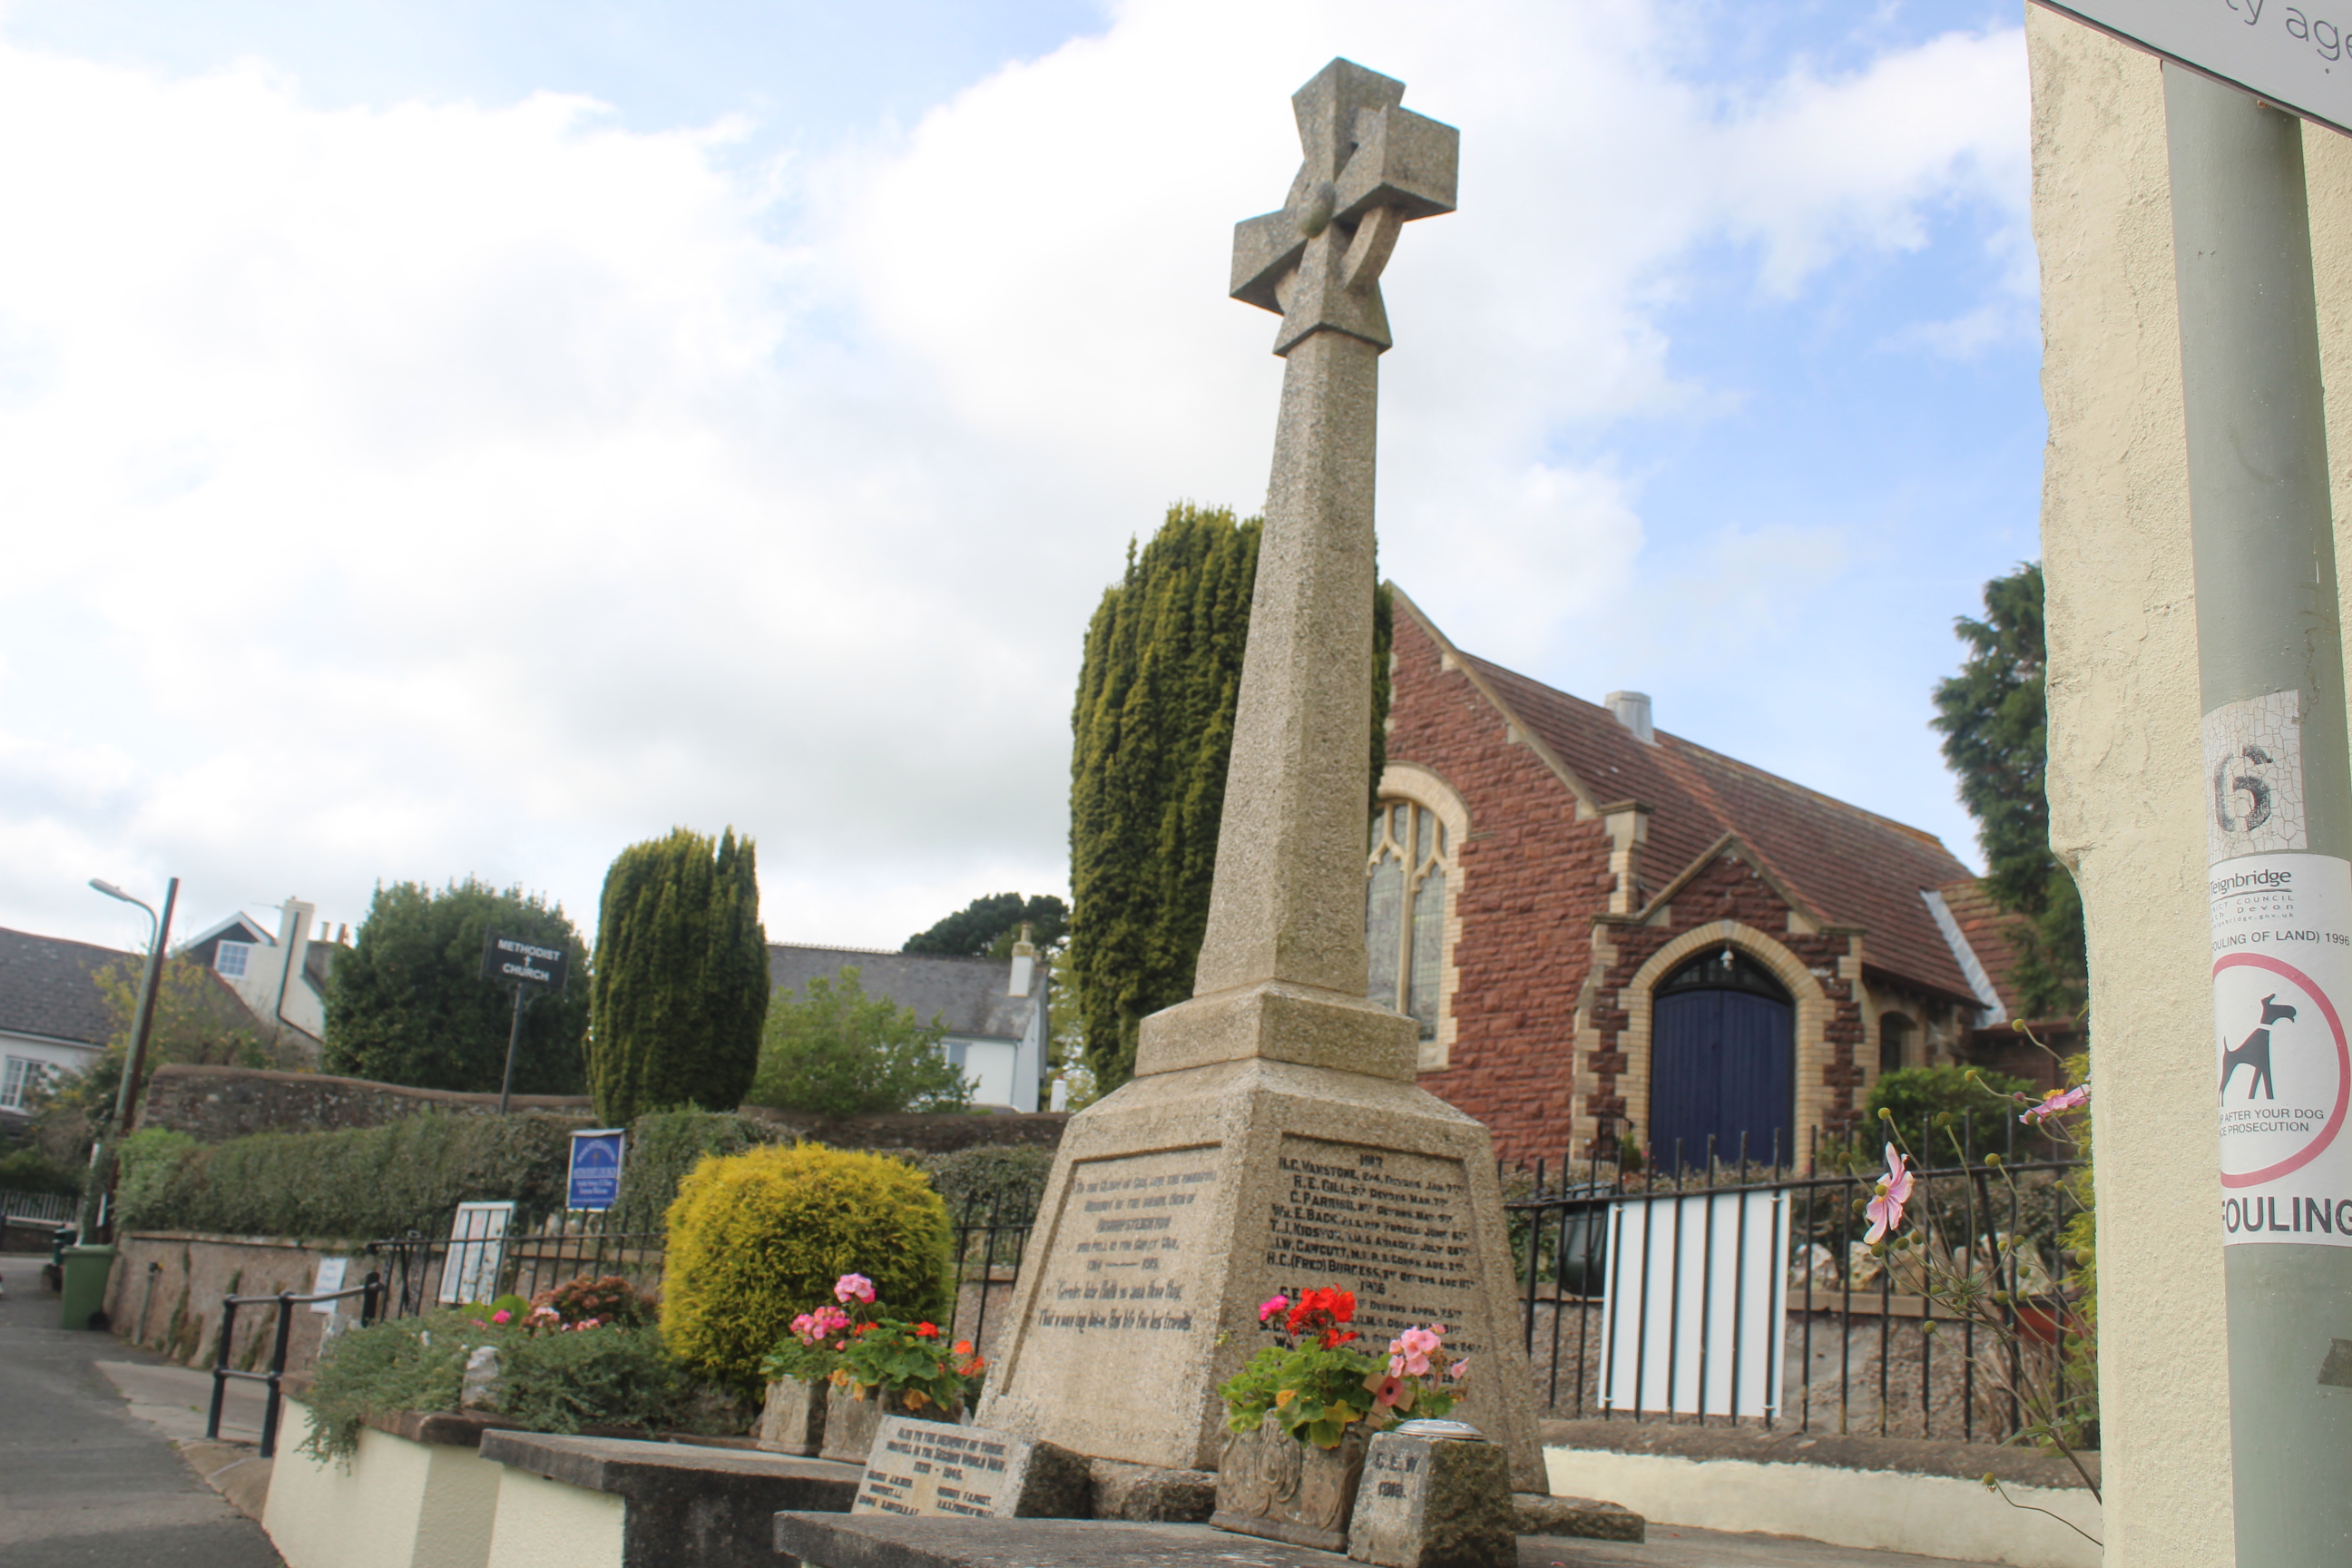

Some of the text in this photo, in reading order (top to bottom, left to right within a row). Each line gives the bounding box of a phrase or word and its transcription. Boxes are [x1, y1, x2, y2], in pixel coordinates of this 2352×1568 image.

[2214, 744, 2274, 832] 6
[2210, 868, 2292, 896] Teignbridge
[2237, 895, 2294, 905] COUNCIL
[2237, 904, 2294, 914] Devon
[2251, 931, 2270, 943] OF
[2276, 930, 2320, 944] LAND)
[2325, 933, 2350, 946] 1996
[497, 938, 562, 962] METHODIST
[502, 963, 551, 981] CHURCH
[2225, 1110, 2251, 1122] AFTER
[2254, 1108, 2290, 1119] YOUR
[2294, 1108, 2324, 1120] DOG
[2228, 1122, 2309, 1135] PROSECUTION
